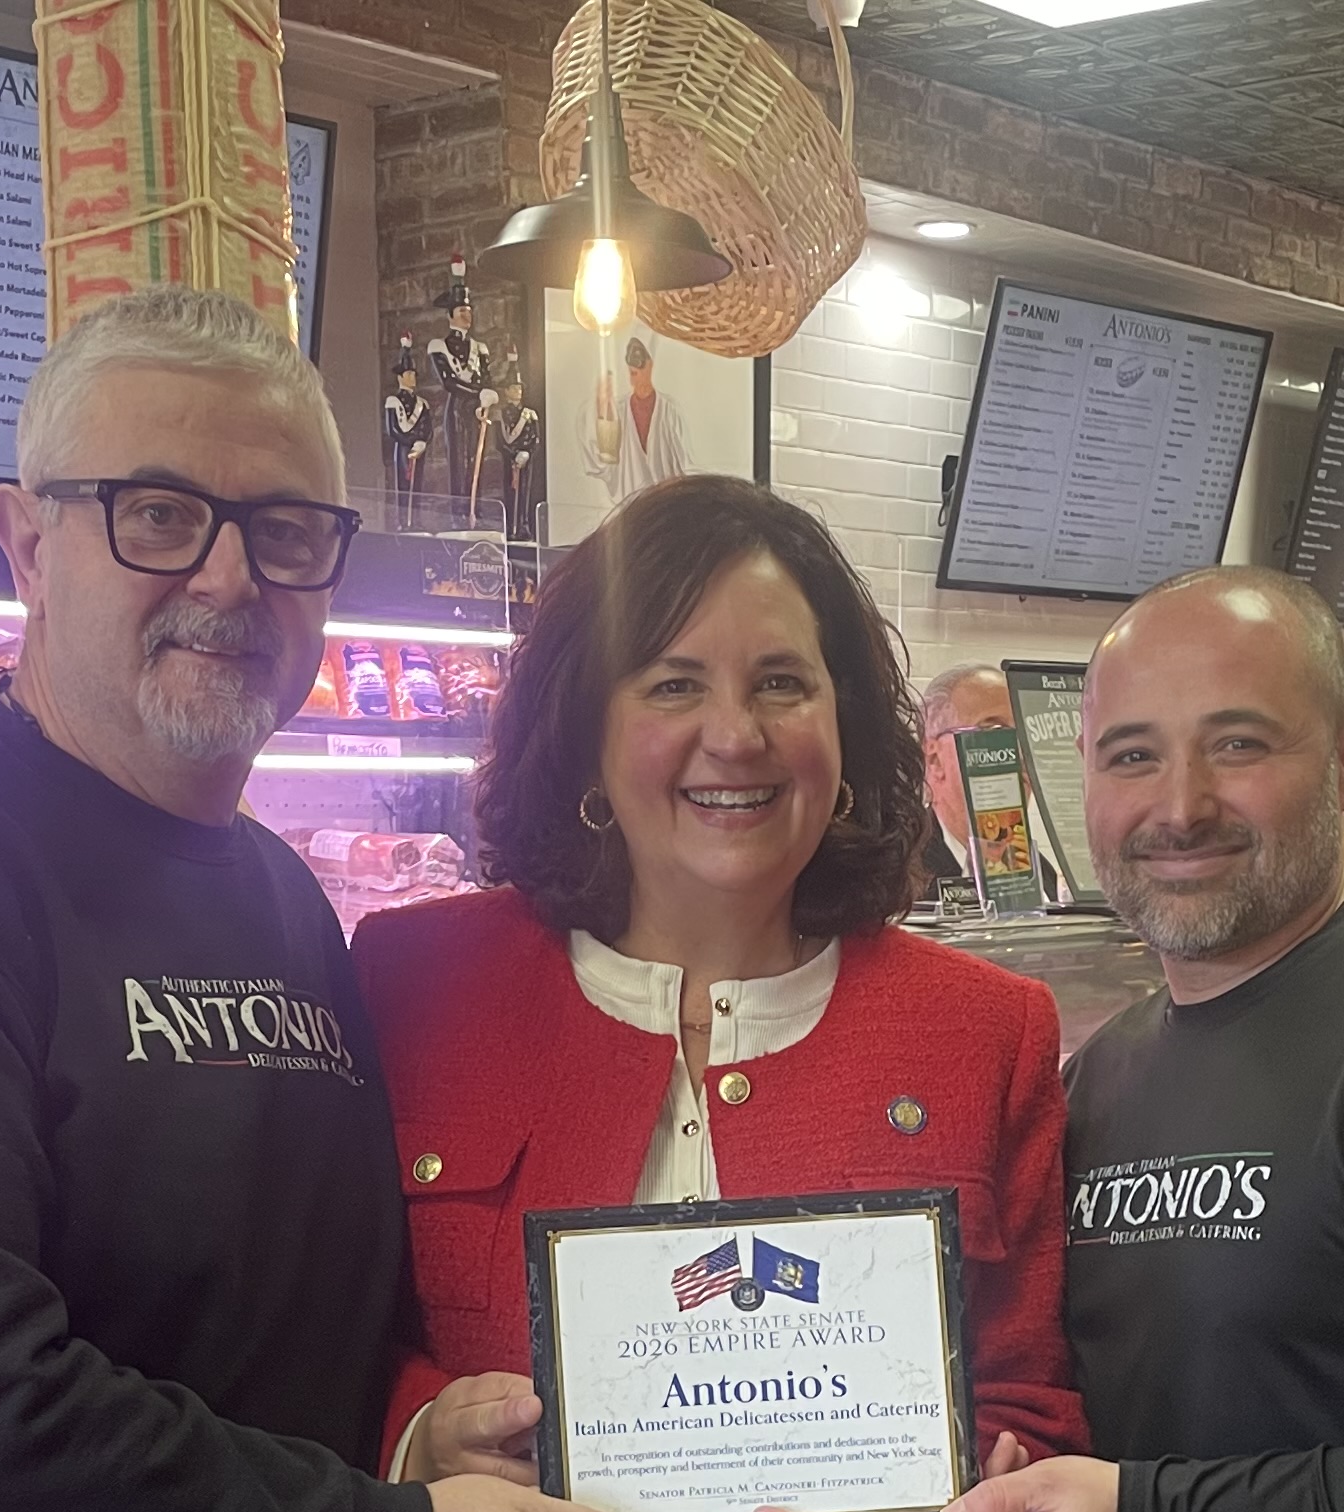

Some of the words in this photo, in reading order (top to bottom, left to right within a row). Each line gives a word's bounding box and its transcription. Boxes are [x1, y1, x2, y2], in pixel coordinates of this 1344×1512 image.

[1020, 303, 1060, 324] PANINI
[1103, 313, 1172, 344] ANTONIO'S
[1026, 711, 1073, 742] SUPER
[161, 975, 232, 994] AUTHENTIC
[233, 979, 284, 993] ITALIAN
[125, 978, 353, 1069] ANTONIO
[1070, 1159, 1271, 1231] NTONIO'S
[1190, 1223, 1261, 1241] CATERING
[636, 1321, 677, 1336] NEW
[684, 1318, 733, 1333] YORK
[740, 1314, 791, 1331] STATE
[799, 1310, 866, 1326] SENATE
[618, 1338, 678, 1358] 2026
[689, 1331, 781, 1354] EMPIRE
[792, 1325, 886, 1347] AWARD
[661, 1364, 847, 1408] Antonio's
[575, 1420, 627, 1436] Italian
[632, 1416, 714, 1433] American
[720, 1409, 824, 1427] Delicatessen
[830, 1404, 861, 1420] and
[867, 1402, 940, 1418] Catering
[601, 1453, 611, 1462] In
[614, 1450, 670, 1463] recognition
[673, 1448, 683, 1458] of
[685, 1444, 743, 1456] outstanding
[745, 1439, 810, 1453] contributions
[814, 1438, 832, 1448] and
[834, 1437, 886, 1447] dedication
[889, 1436, 899, 1444] to
[901, 1434, 917, 1443] the
[617, 1463, 668, 1477] prosperity
[671, 1461, 689, 1472] and
[692, 1459, 746, 1470] betterment
[749, 1456, 759, 1467] of
[761, 1455, 784, 1467] their
[787, 1453, 842, 1465] community
[846, 1451, 864, 1461] and
[867, 1450, 889, 1459] New
[891, 1448, 915, 1458] York
